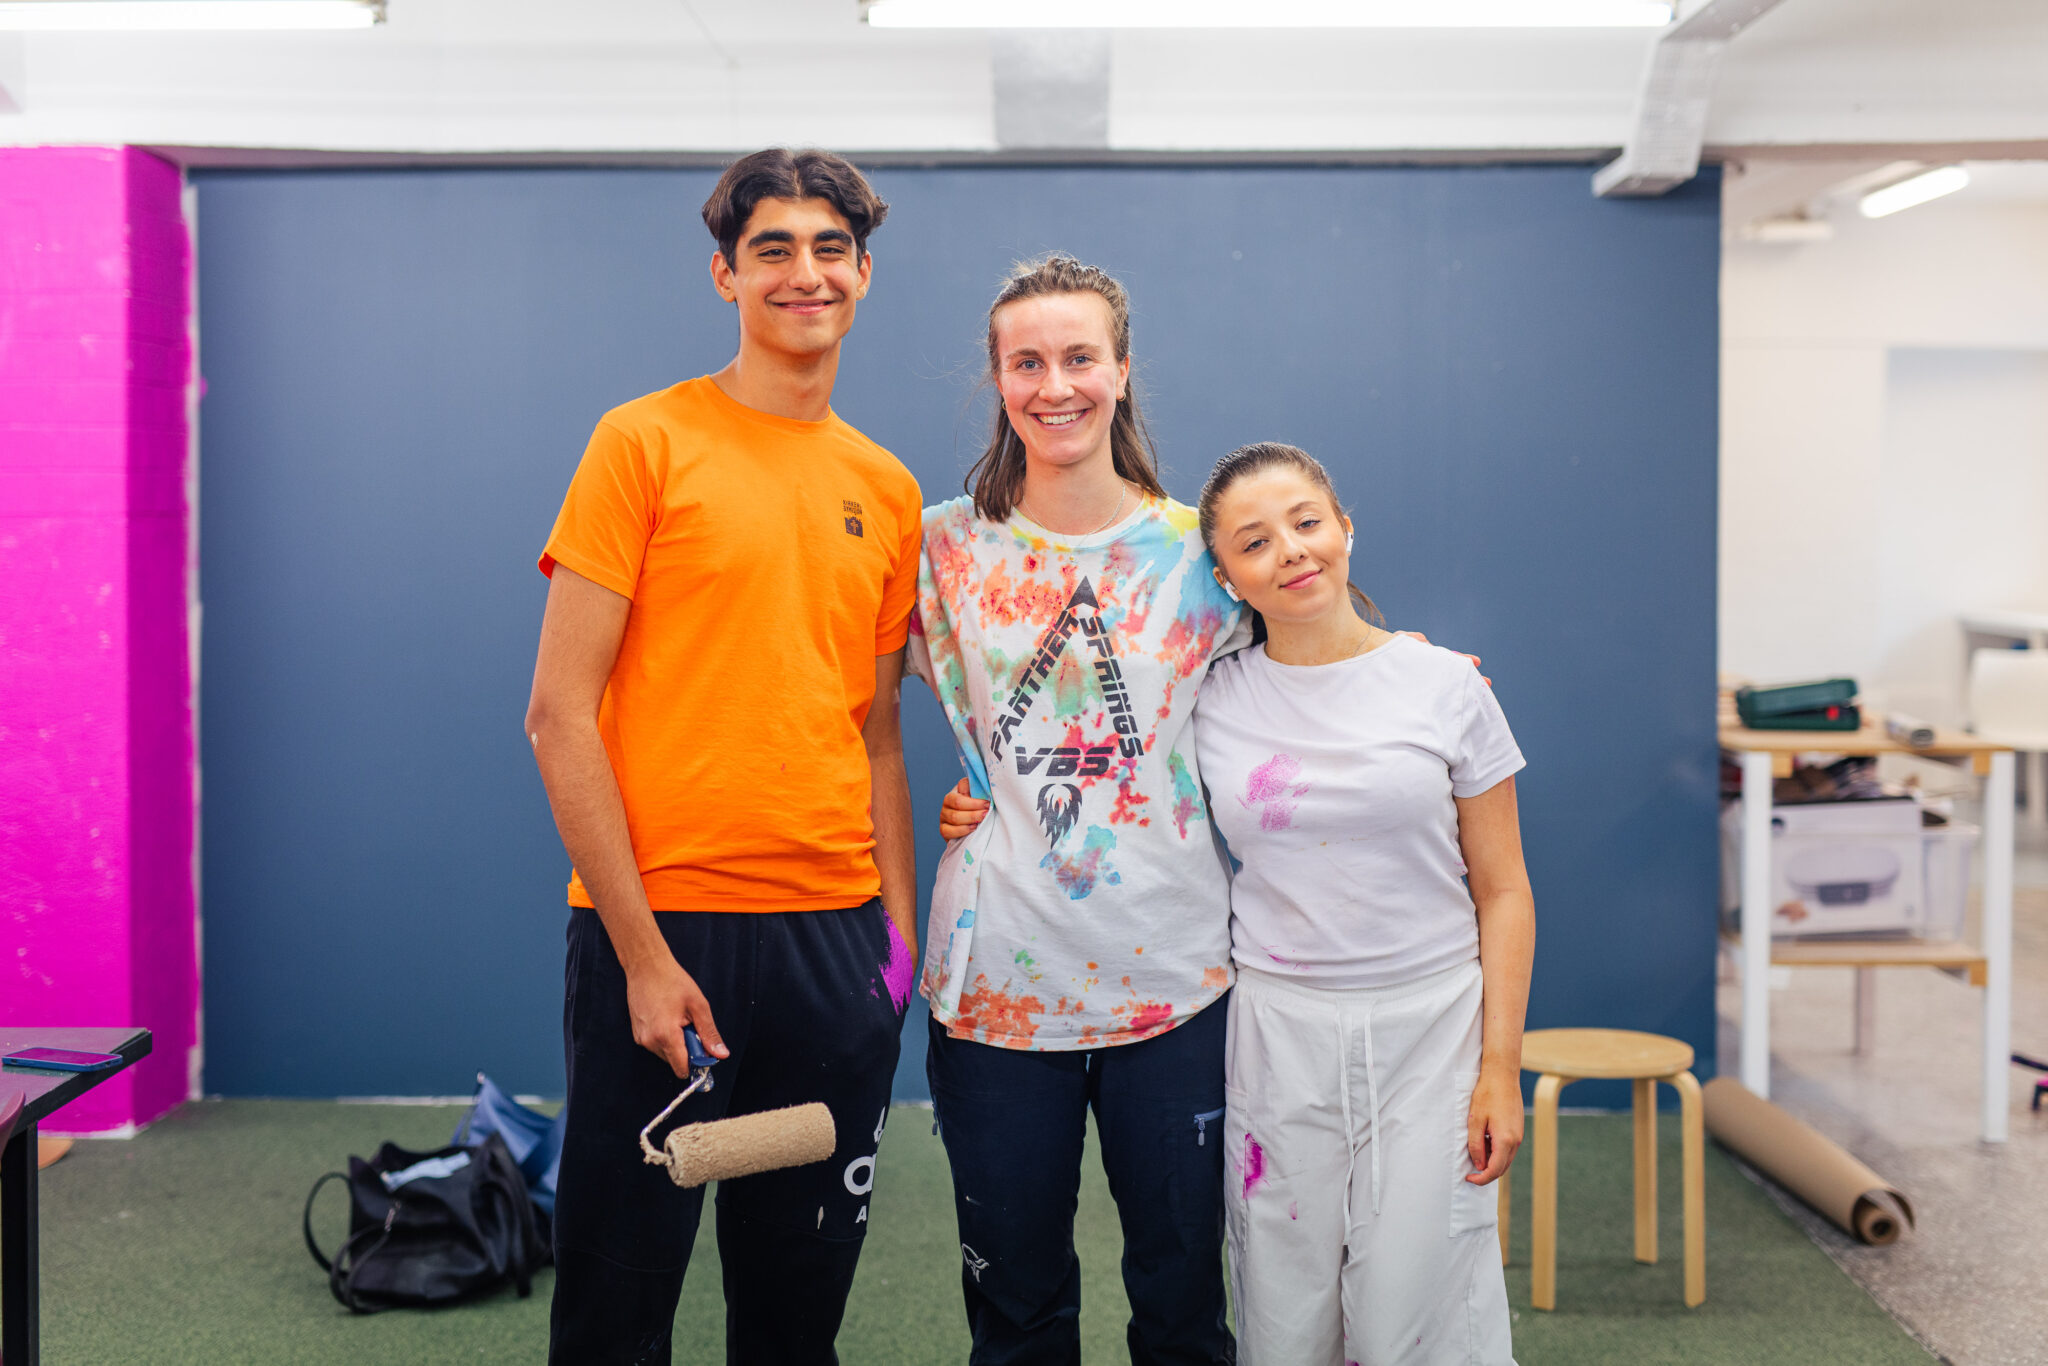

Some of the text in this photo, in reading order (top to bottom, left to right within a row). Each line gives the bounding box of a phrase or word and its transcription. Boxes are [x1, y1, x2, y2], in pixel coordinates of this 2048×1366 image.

[991, 610, 1079, 762] PANTHER
[1079, 616, 1144, 758] SPRINGS
[1014, 746, 1114, 776] VBS
